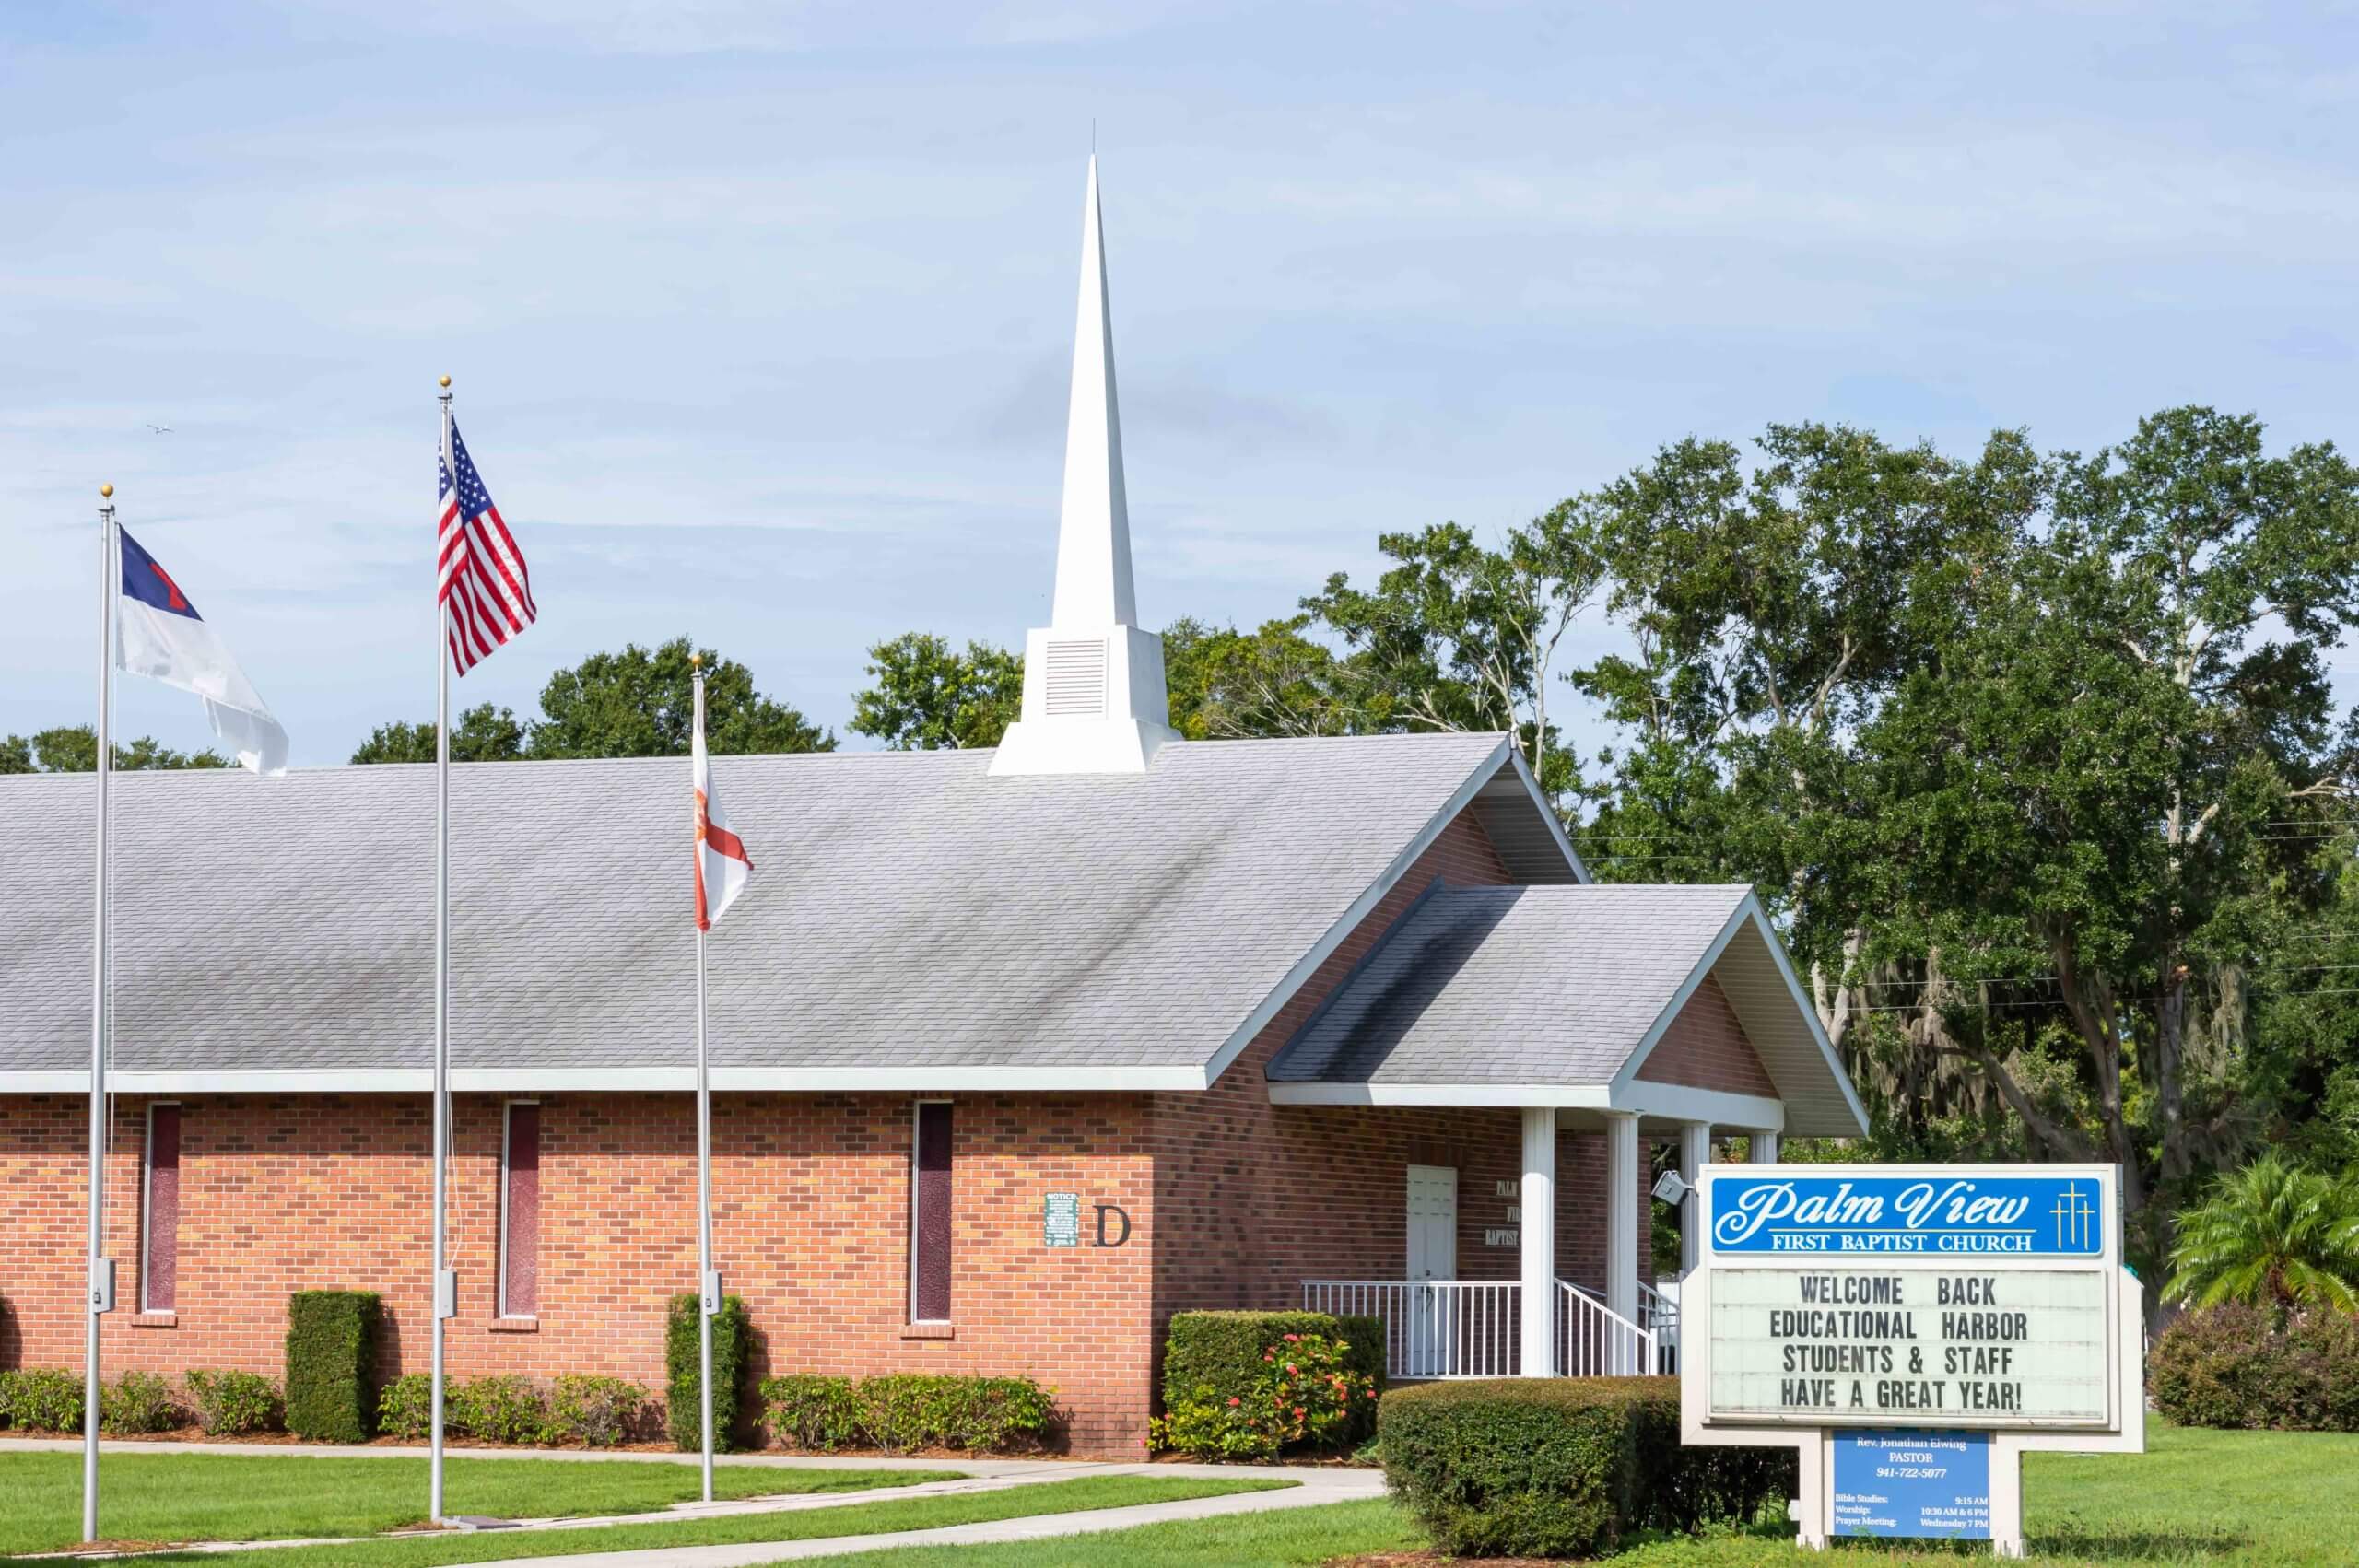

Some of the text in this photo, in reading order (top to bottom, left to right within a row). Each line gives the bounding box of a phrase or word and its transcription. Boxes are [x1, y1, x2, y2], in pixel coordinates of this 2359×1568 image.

[1714, 1181, 2030, 1245] Palm View
[1092, 1205, 1132, 1247] D
[1772, 1235, 2032, 1251] FIRST BAPTIST CHURCH
[1800, 1276, 1996, 1305] WELCOME BACK
[1770, 1310, 2027, 1340] EDUCATIONAL HARBOR
[1783, 1344, 2013, 1375] STUDENTS & STAFF
[1781, 1379, 2022, 1410] HAVE A GREAT YEAR!
[1857, 1437, 1878, 1447] Rev.
[1880, 1437, 1927, 1448] Jonathan
[1889, 1452, 1933, 1463] PASTOR
[1876, 1467, 1947, 1478] 941-722-5077
[1835, 1493, 1856, 1503] Bible
[1954, 1496, 1988, 1505] 9:15 AM
[1835, 1505, 1872, 1515] Worship:
[1921, 1507, 1942, 1515] 10:30
[1959, 1508, 1966, 1516] &
[1974, 1508, 1989, 1516] PM
[1835, 1516, 1898, 1527] Prayer Meeting:
[1920, 1518, 1989, 1528] Wednesday 7 PM
